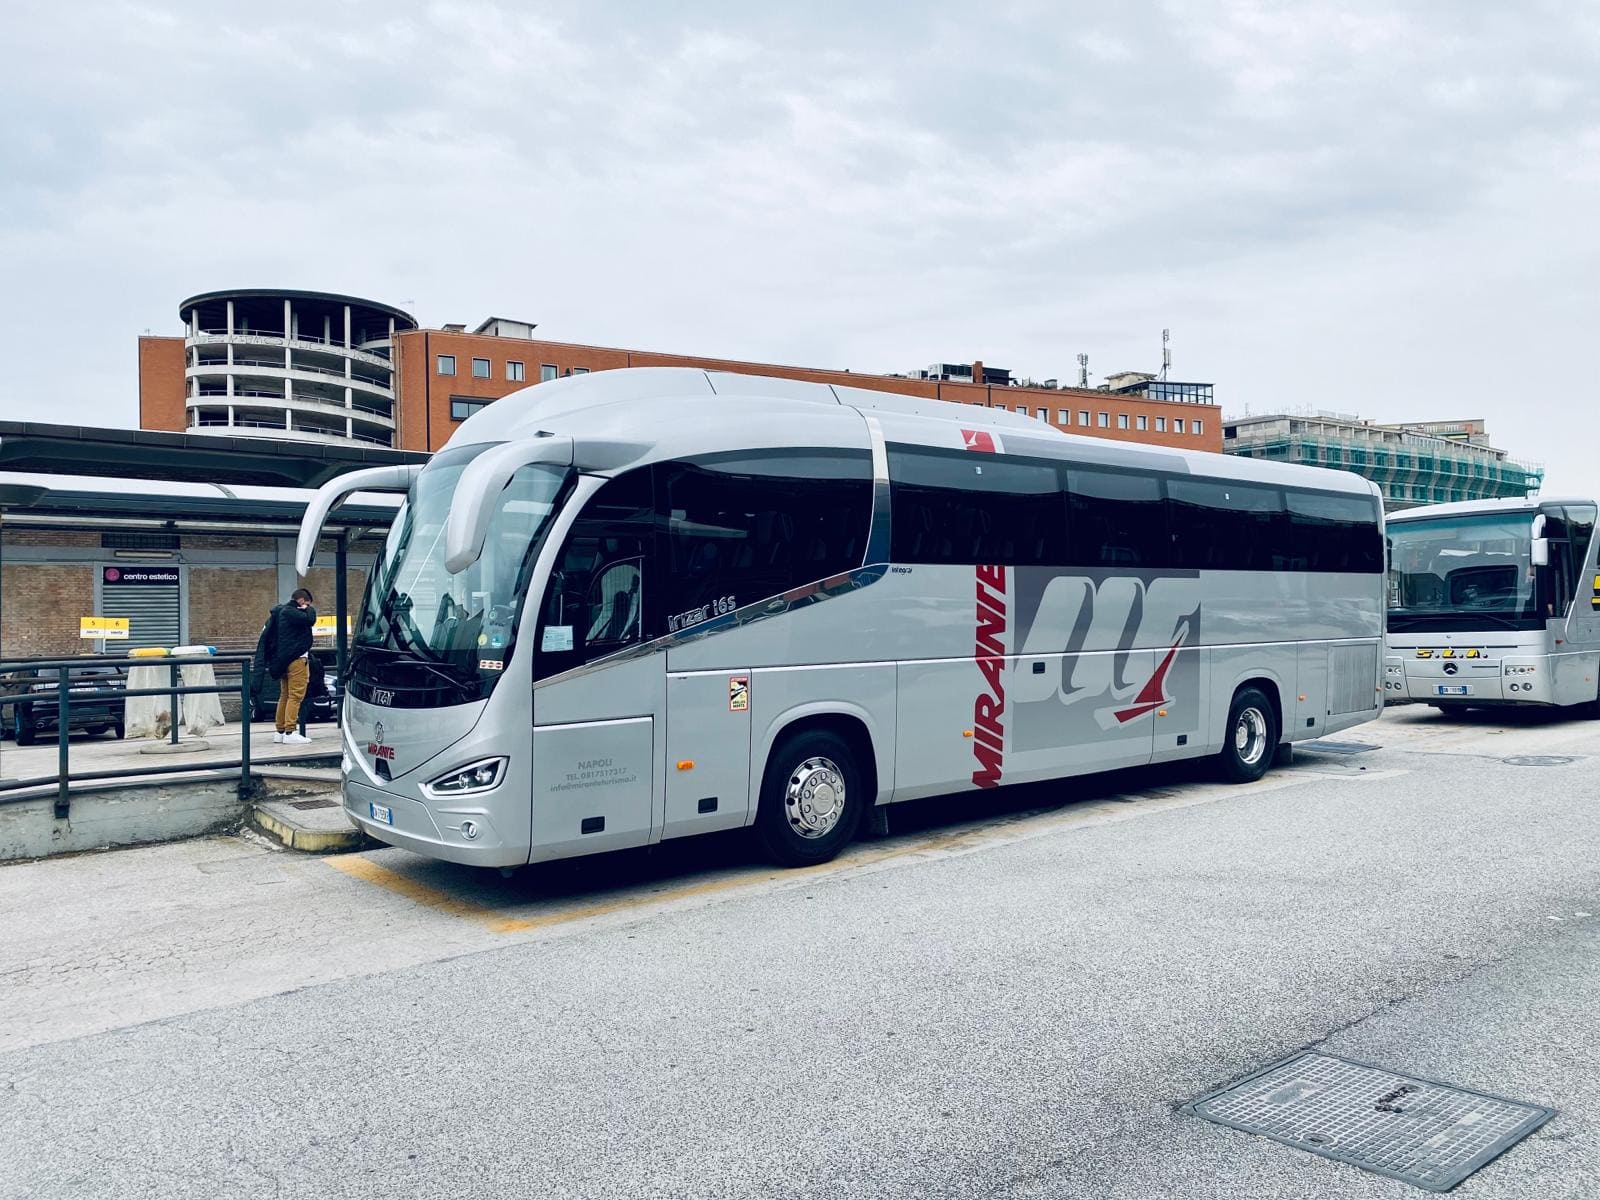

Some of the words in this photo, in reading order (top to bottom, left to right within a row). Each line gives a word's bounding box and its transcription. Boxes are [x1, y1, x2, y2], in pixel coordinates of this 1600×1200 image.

[149, 572, 178, 580] estetico
[667, 604, 710, 632] irizar
[712, 595, 737, 616] i6s
[972, 565, 1007, 789] MIRANTE
[367, 742, 395, 760] MIRANTE
[578, 758, 612, 770] NAPOLI
